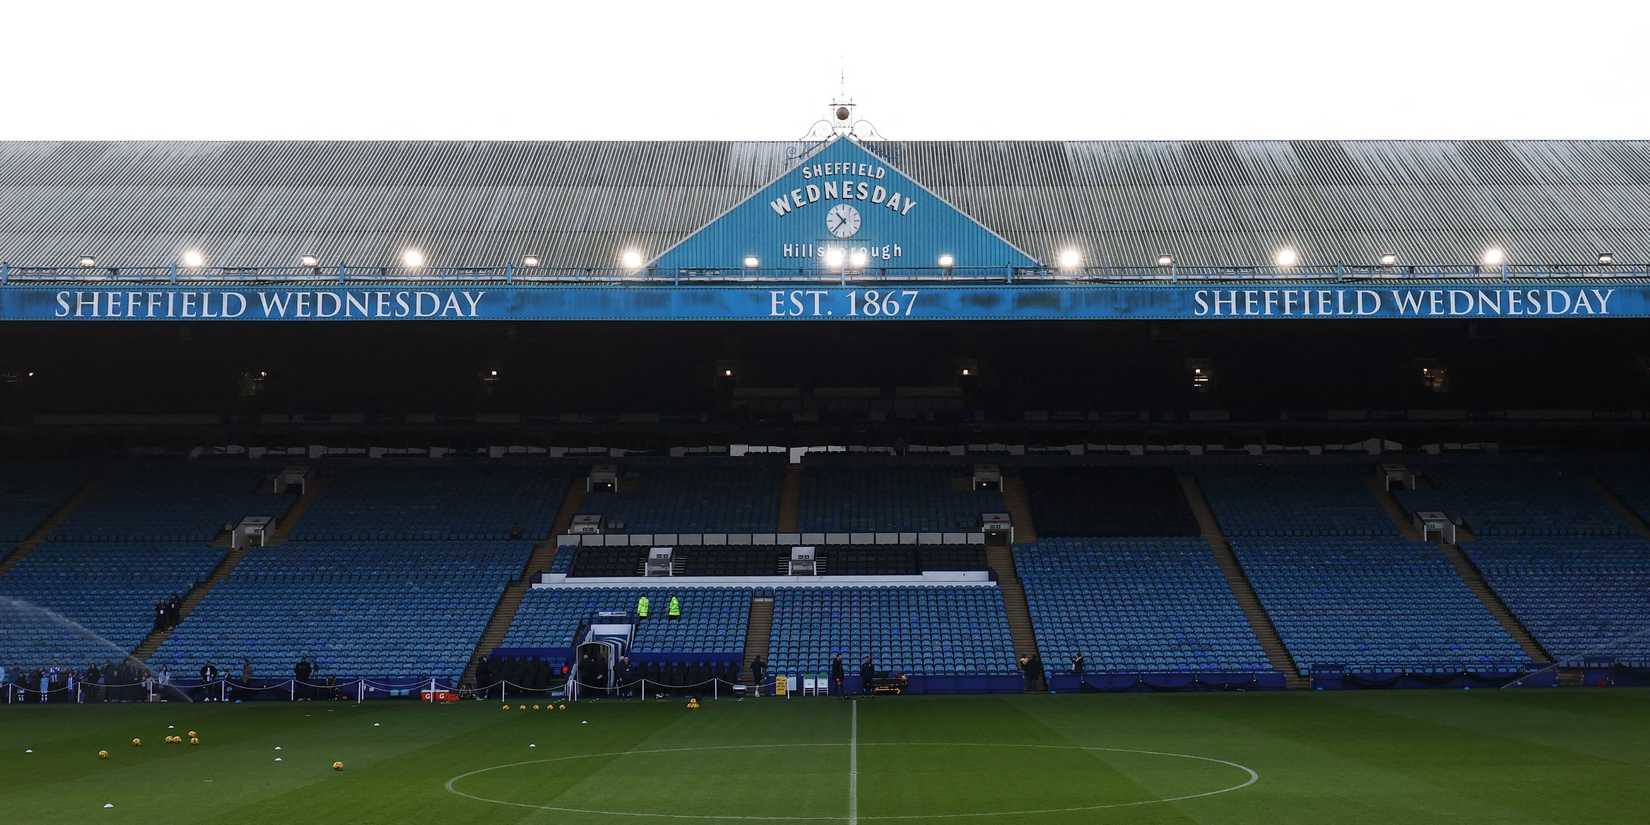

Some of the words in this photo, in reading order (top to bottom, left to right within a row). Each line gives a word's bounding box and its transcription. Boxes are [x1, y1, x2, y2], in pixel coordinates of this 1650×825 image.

[802, 162, 886, 180] SHEFFIELD
[770, 180, 917, 218] WEDNESDAY
[783, 243, 903, 260] Hillsorough
[54, 291, 248, 318] SHEFFIELD
[257, 291, 487, 318] WEDNESDAY
[770, 290, 833, 317] EST.
[846, 290, 919, 317] 1867
[1193, 289, 1382, 316] SHEFFIELD
[1391, 289, 1615, 316] WEDNESDAY
